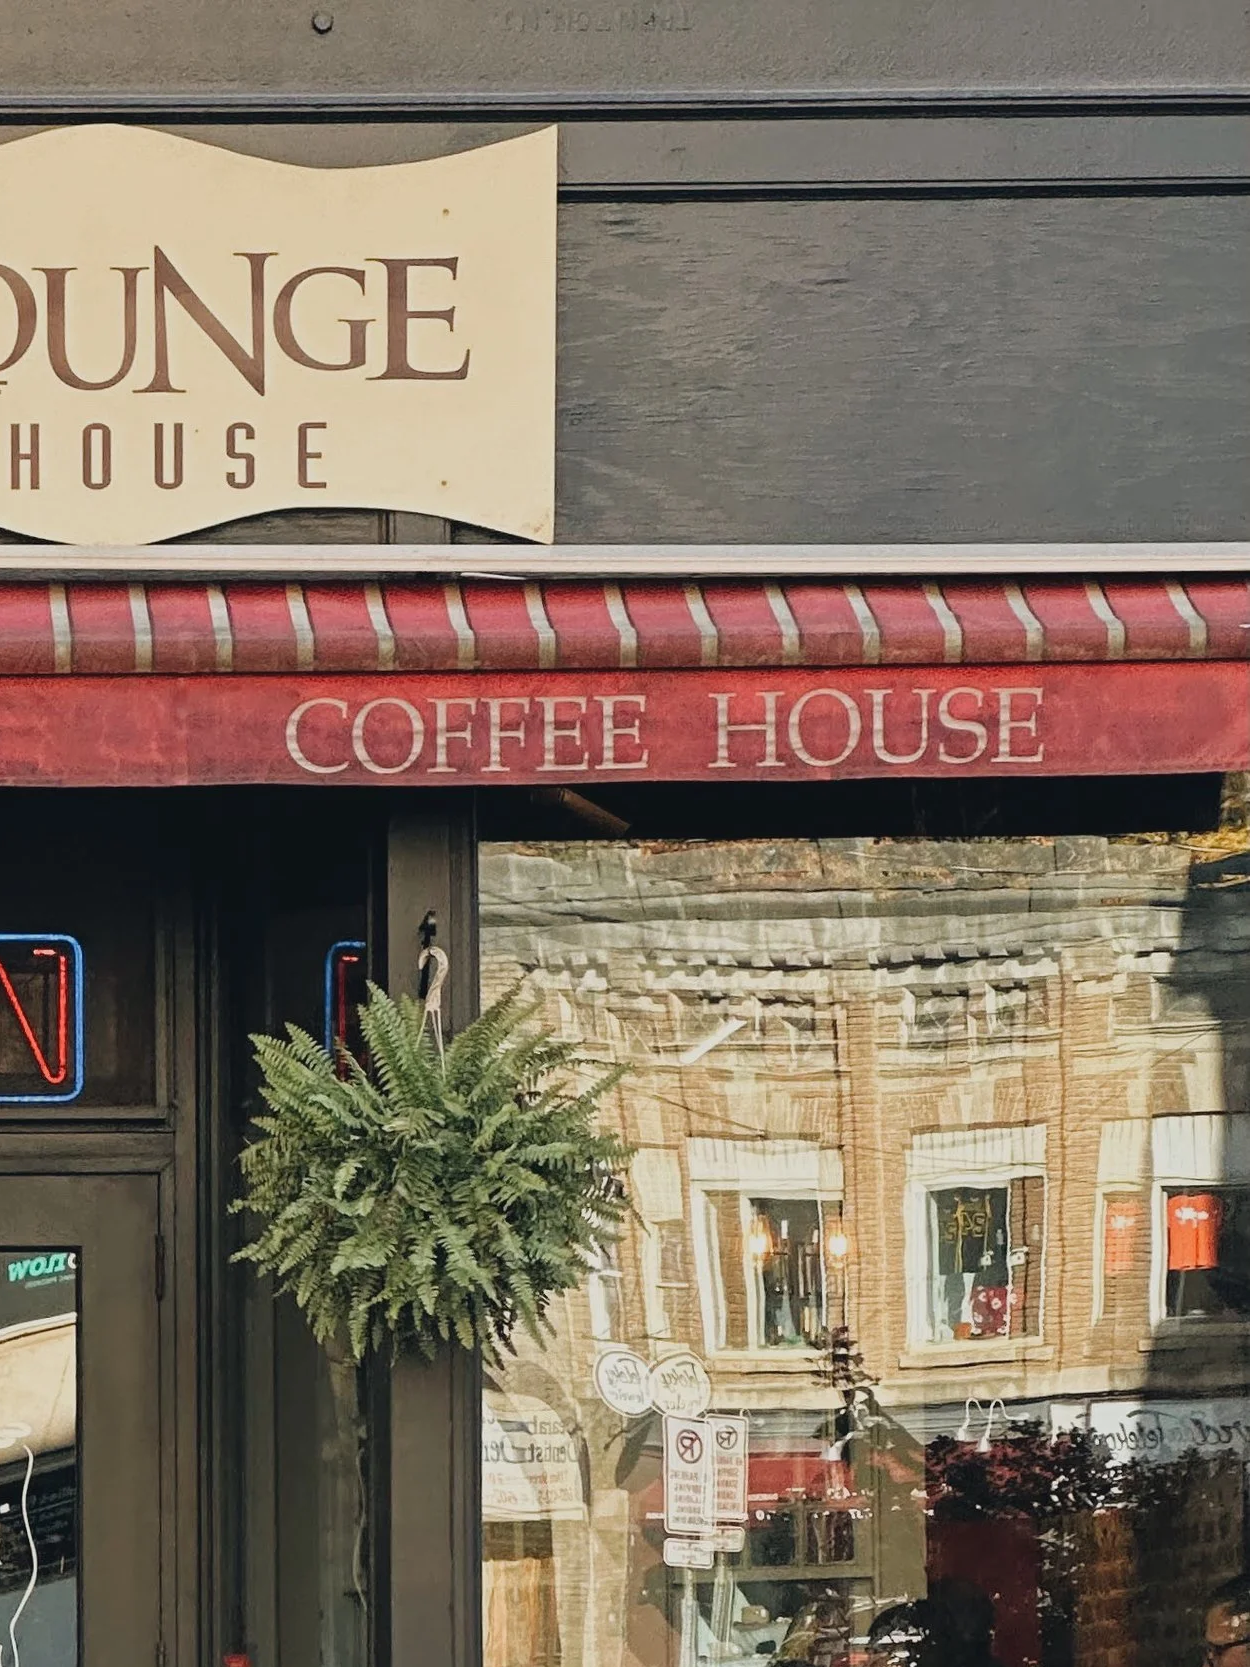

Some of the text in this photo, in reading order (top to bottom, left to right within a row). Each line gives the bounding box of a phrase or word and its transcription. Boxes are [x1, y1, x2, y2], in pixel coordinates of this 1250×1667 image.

[10, 422, 328, 490] HOUSE
[285, 687, 1045, 775] COFFEE HOUSE
